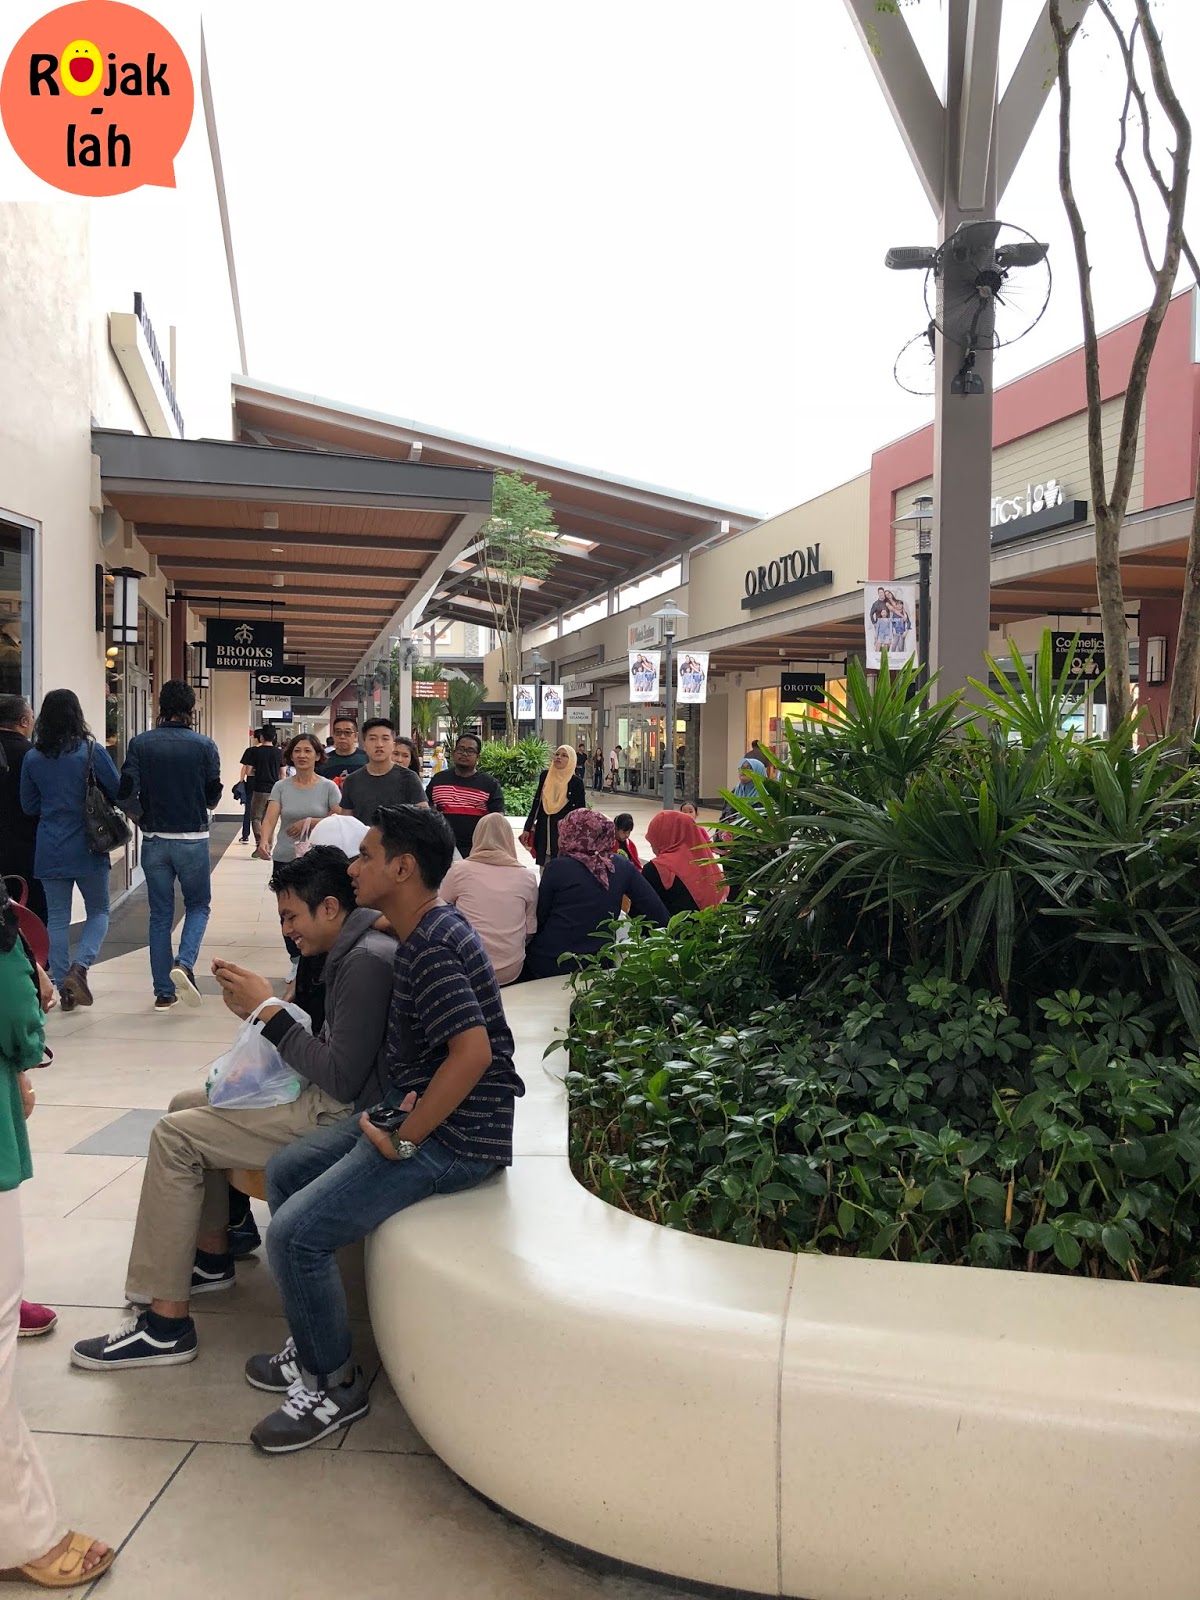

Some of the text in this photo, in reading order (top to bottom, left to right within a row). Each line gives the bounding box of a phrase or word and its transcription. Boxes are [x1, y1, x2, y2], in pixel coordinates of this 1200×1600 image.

[745, 543, 821, 596] OROTON
[1056, 637, 1105, 648] Cometic
[216, 645, 273, 658] BROOKS
[216, 657, 273, 668] BROTHERS
[257, 674, 303, 685] GEOX
[280, 1361, 301, 1383] N
[313, 1397, 340, 1425] N
